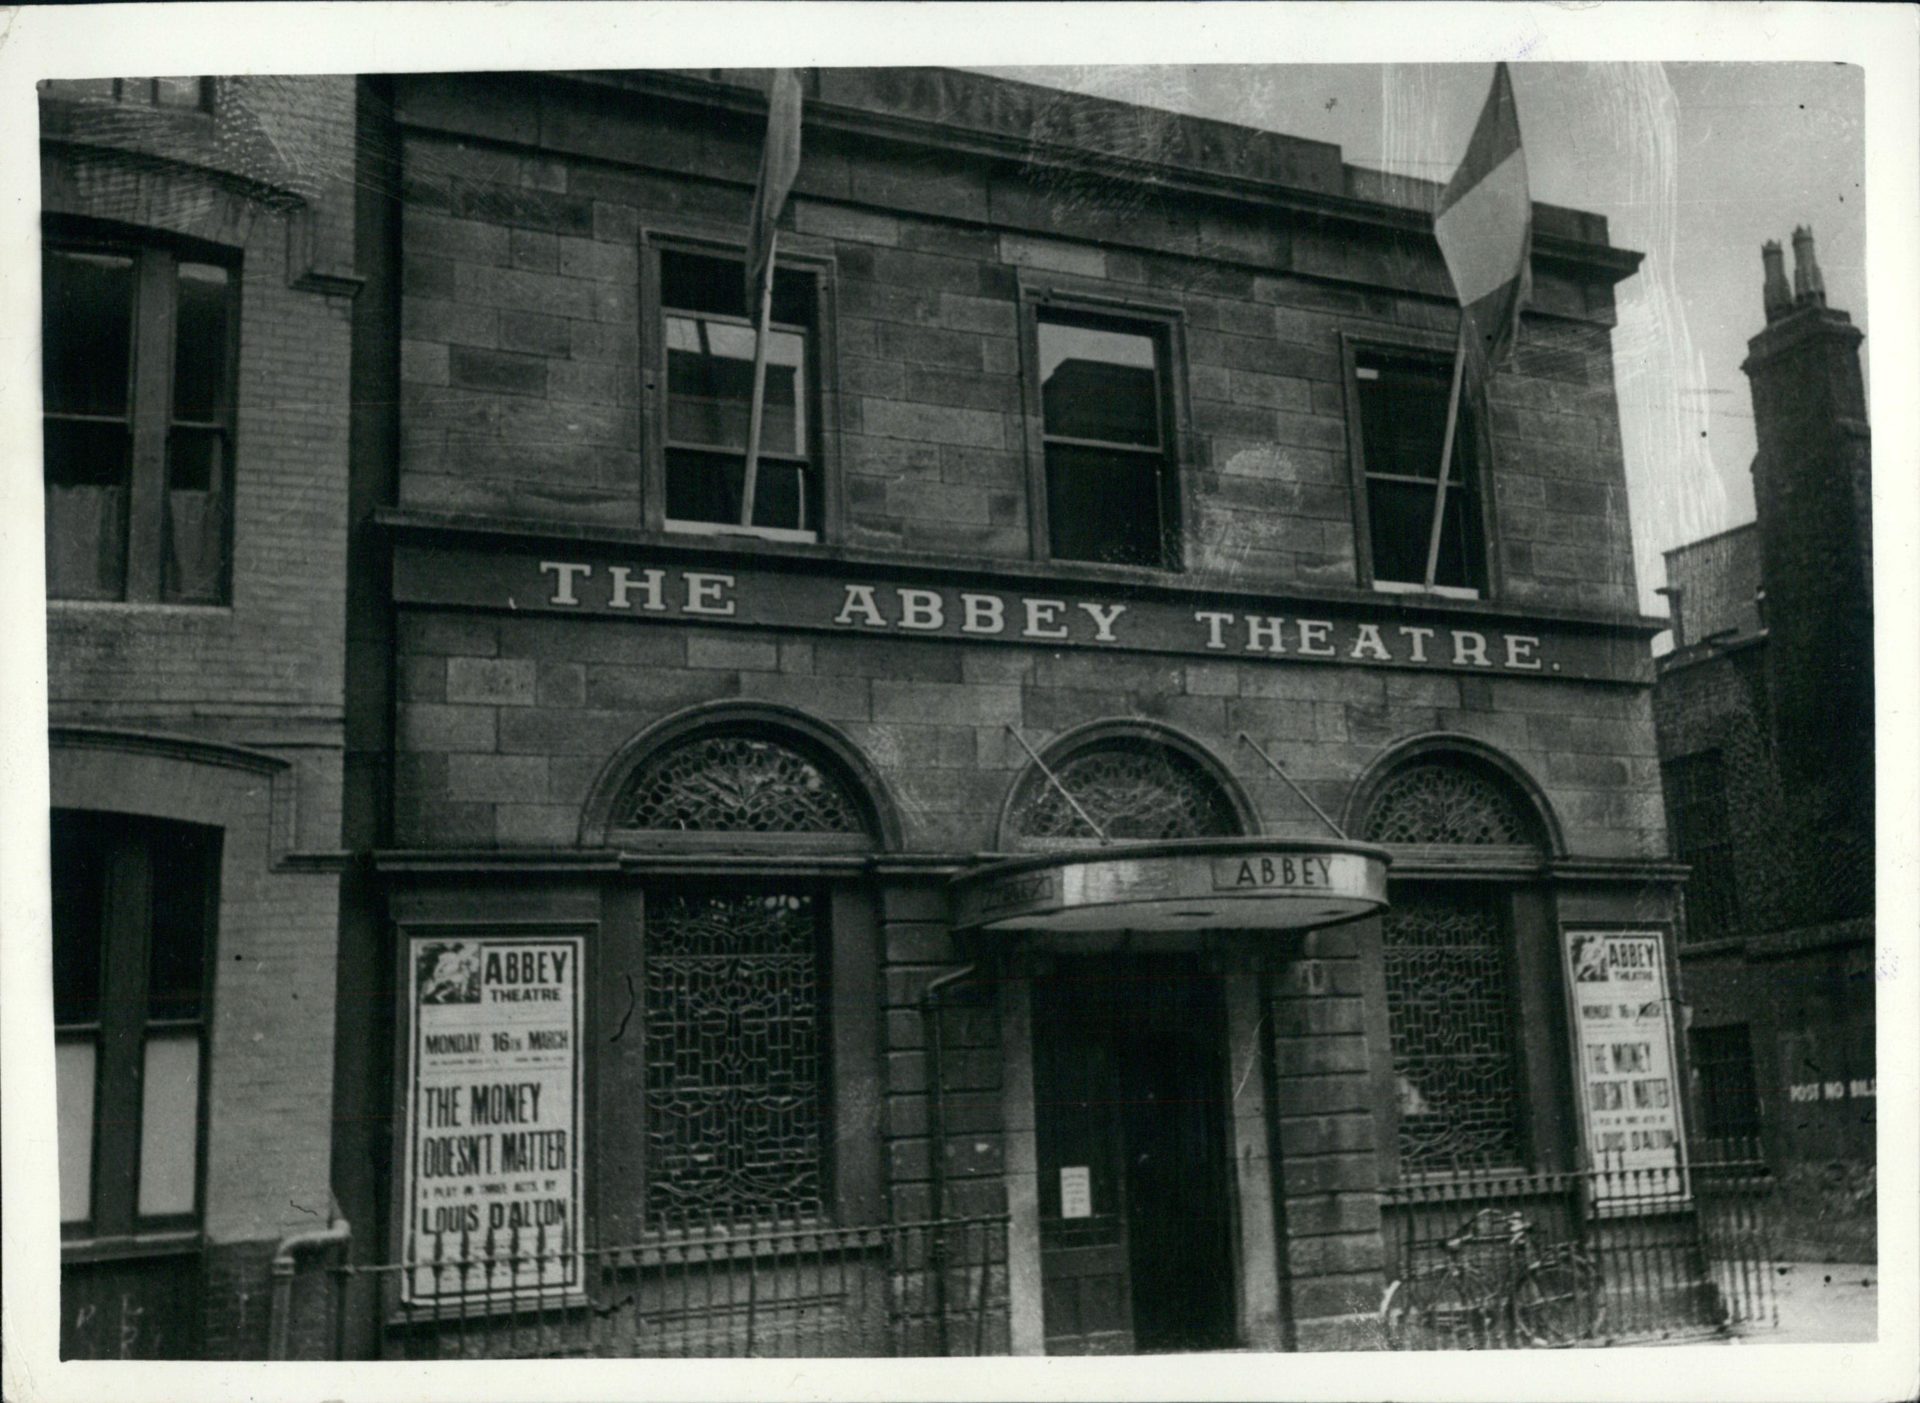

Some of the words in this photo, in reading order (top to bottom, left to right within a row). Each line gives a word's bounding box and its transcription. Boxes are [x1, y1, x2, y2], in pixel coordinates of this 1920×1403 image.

[540, 561, 735, 615] THE
[834, 584, 1126, 641] ABBEY
[1195, 611, 1561, 671] THEATRE.
[1236, 857, 1332, 887] ABBEY
[485, 950, 567, 985] ABBEY
[1609, 943, 1655, 968] ABBEY
[490, 987, 561, 1003] THEATRE
[424, 1085, 462, 1129] THE
[470, 1081, 541, 1126] MONEY
[501, 1129, 567, 1174] MATTER
[422, 1203, 480, 1235] LOUIS
